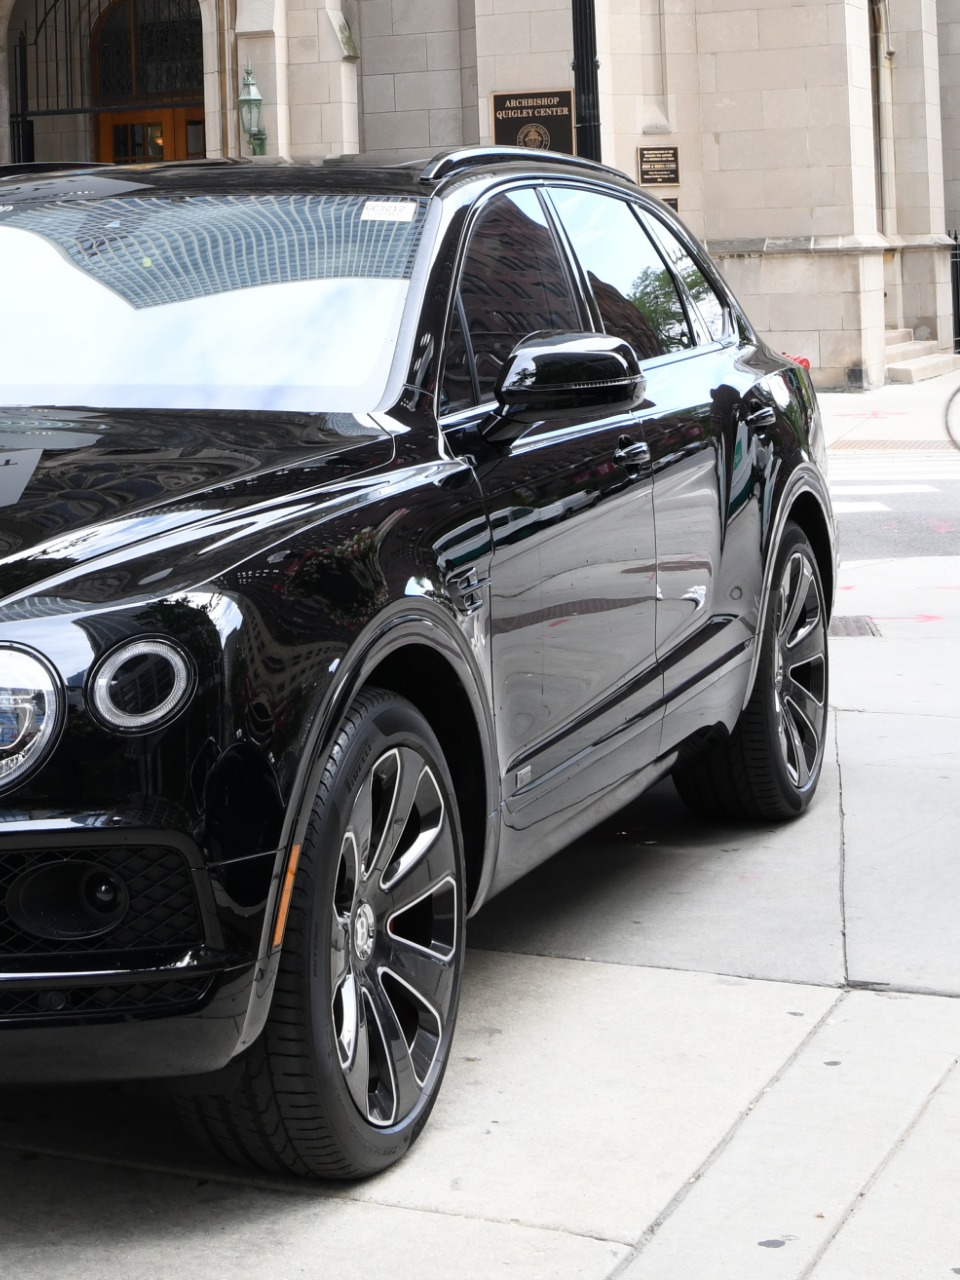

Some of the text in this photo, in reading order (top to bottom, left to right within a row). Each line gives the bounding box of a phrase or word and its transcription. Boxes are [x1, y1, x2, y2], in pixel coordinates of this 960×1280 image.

[505, 97, 559, 108] ARCHBISHOP
[496, 107, 569, 120] QUIGLEY CENTER
